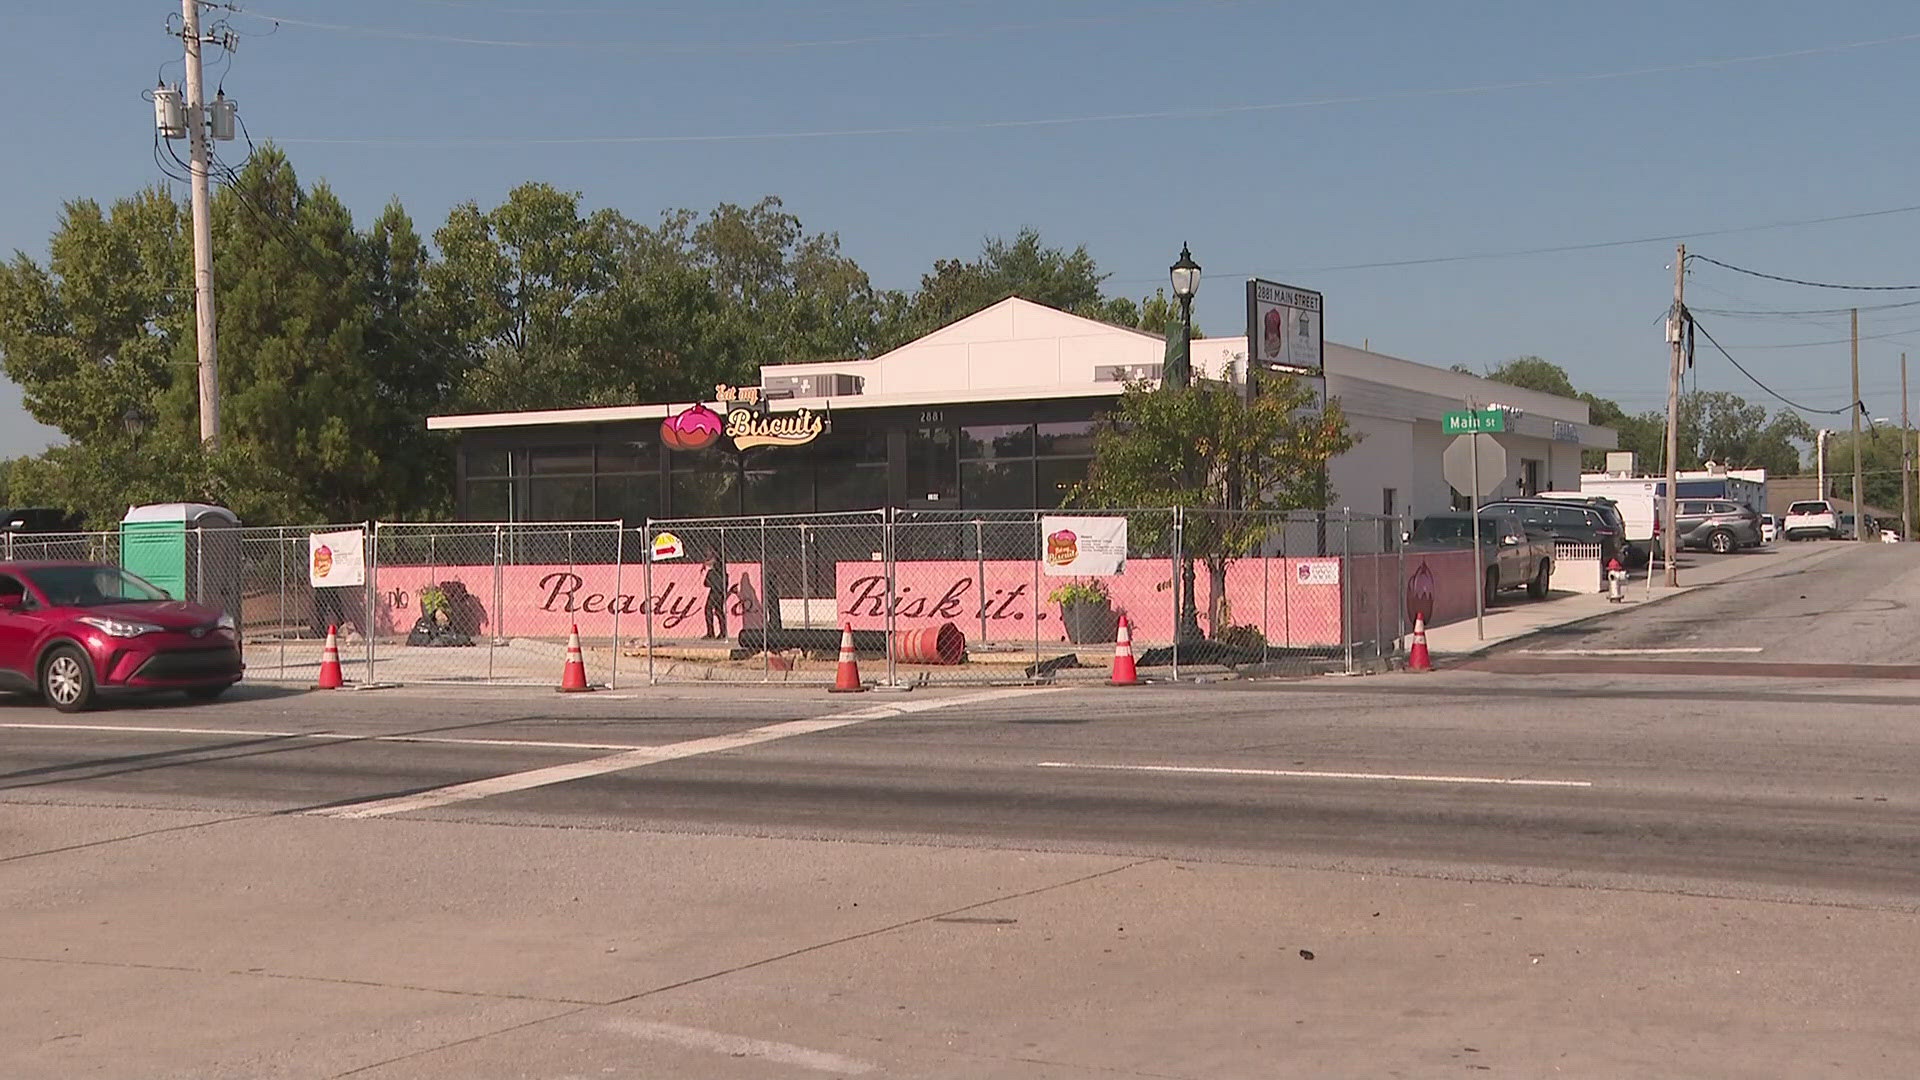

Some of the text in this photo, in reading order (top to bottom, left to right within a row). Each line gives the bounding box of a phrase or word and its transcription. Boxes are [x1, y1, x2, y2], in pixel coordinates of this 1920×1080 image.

[1274, 290, 1293, 304] MAIN
[1294, 293, 1319, 309] STREET
[715, 384, 759, 405] Eat my
[726, 408, 823, 437] Biscuits
[920, 411, 944, 422] 2881
[1450, 416, 1481, 429] Main
[539, 572, 702, 629] Ready
[841, 575, 973, 619] Risk
